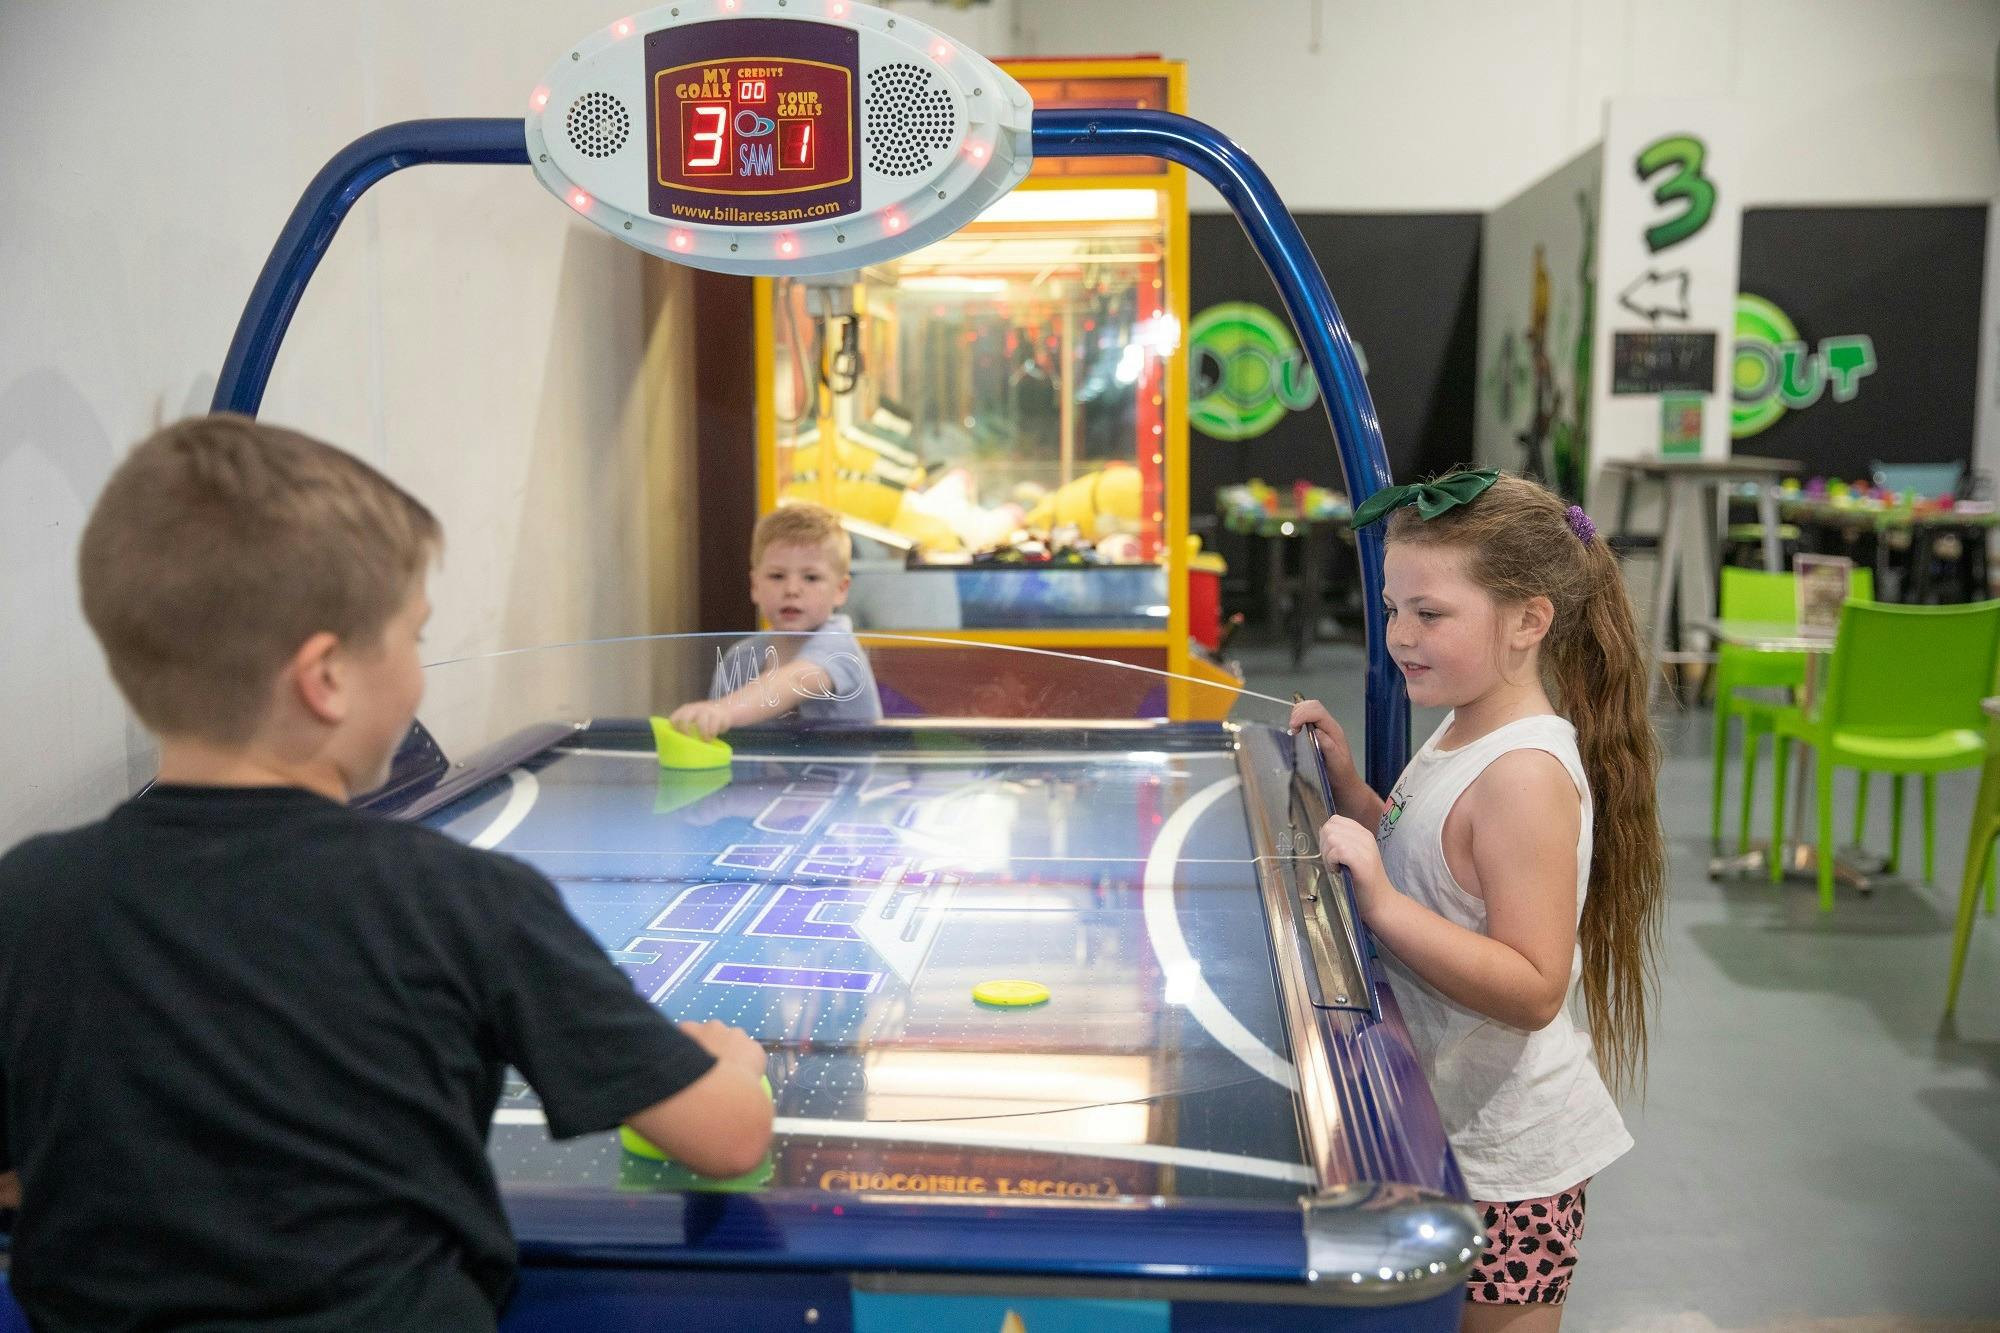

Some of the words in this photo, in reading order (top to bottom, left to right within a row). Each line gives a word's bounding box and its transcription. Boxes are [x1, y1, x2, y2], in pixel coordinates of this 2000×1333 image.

[703, 68, 731, 84] MY
[738, 68, 784, 78] CREDITS
[675, 83, 732, 98] GOALS
[741, 82, 765, 99] 00
[777, 91, 819, 104] YOUR
[777, 104, 822, 116] GOALS
[687, 106, 727, 167] 3
[739, 143, 774, 176] SAM
[1635, 132, 1717, 253] 3
[671, 201, 840, 222] www.billaressam.com
